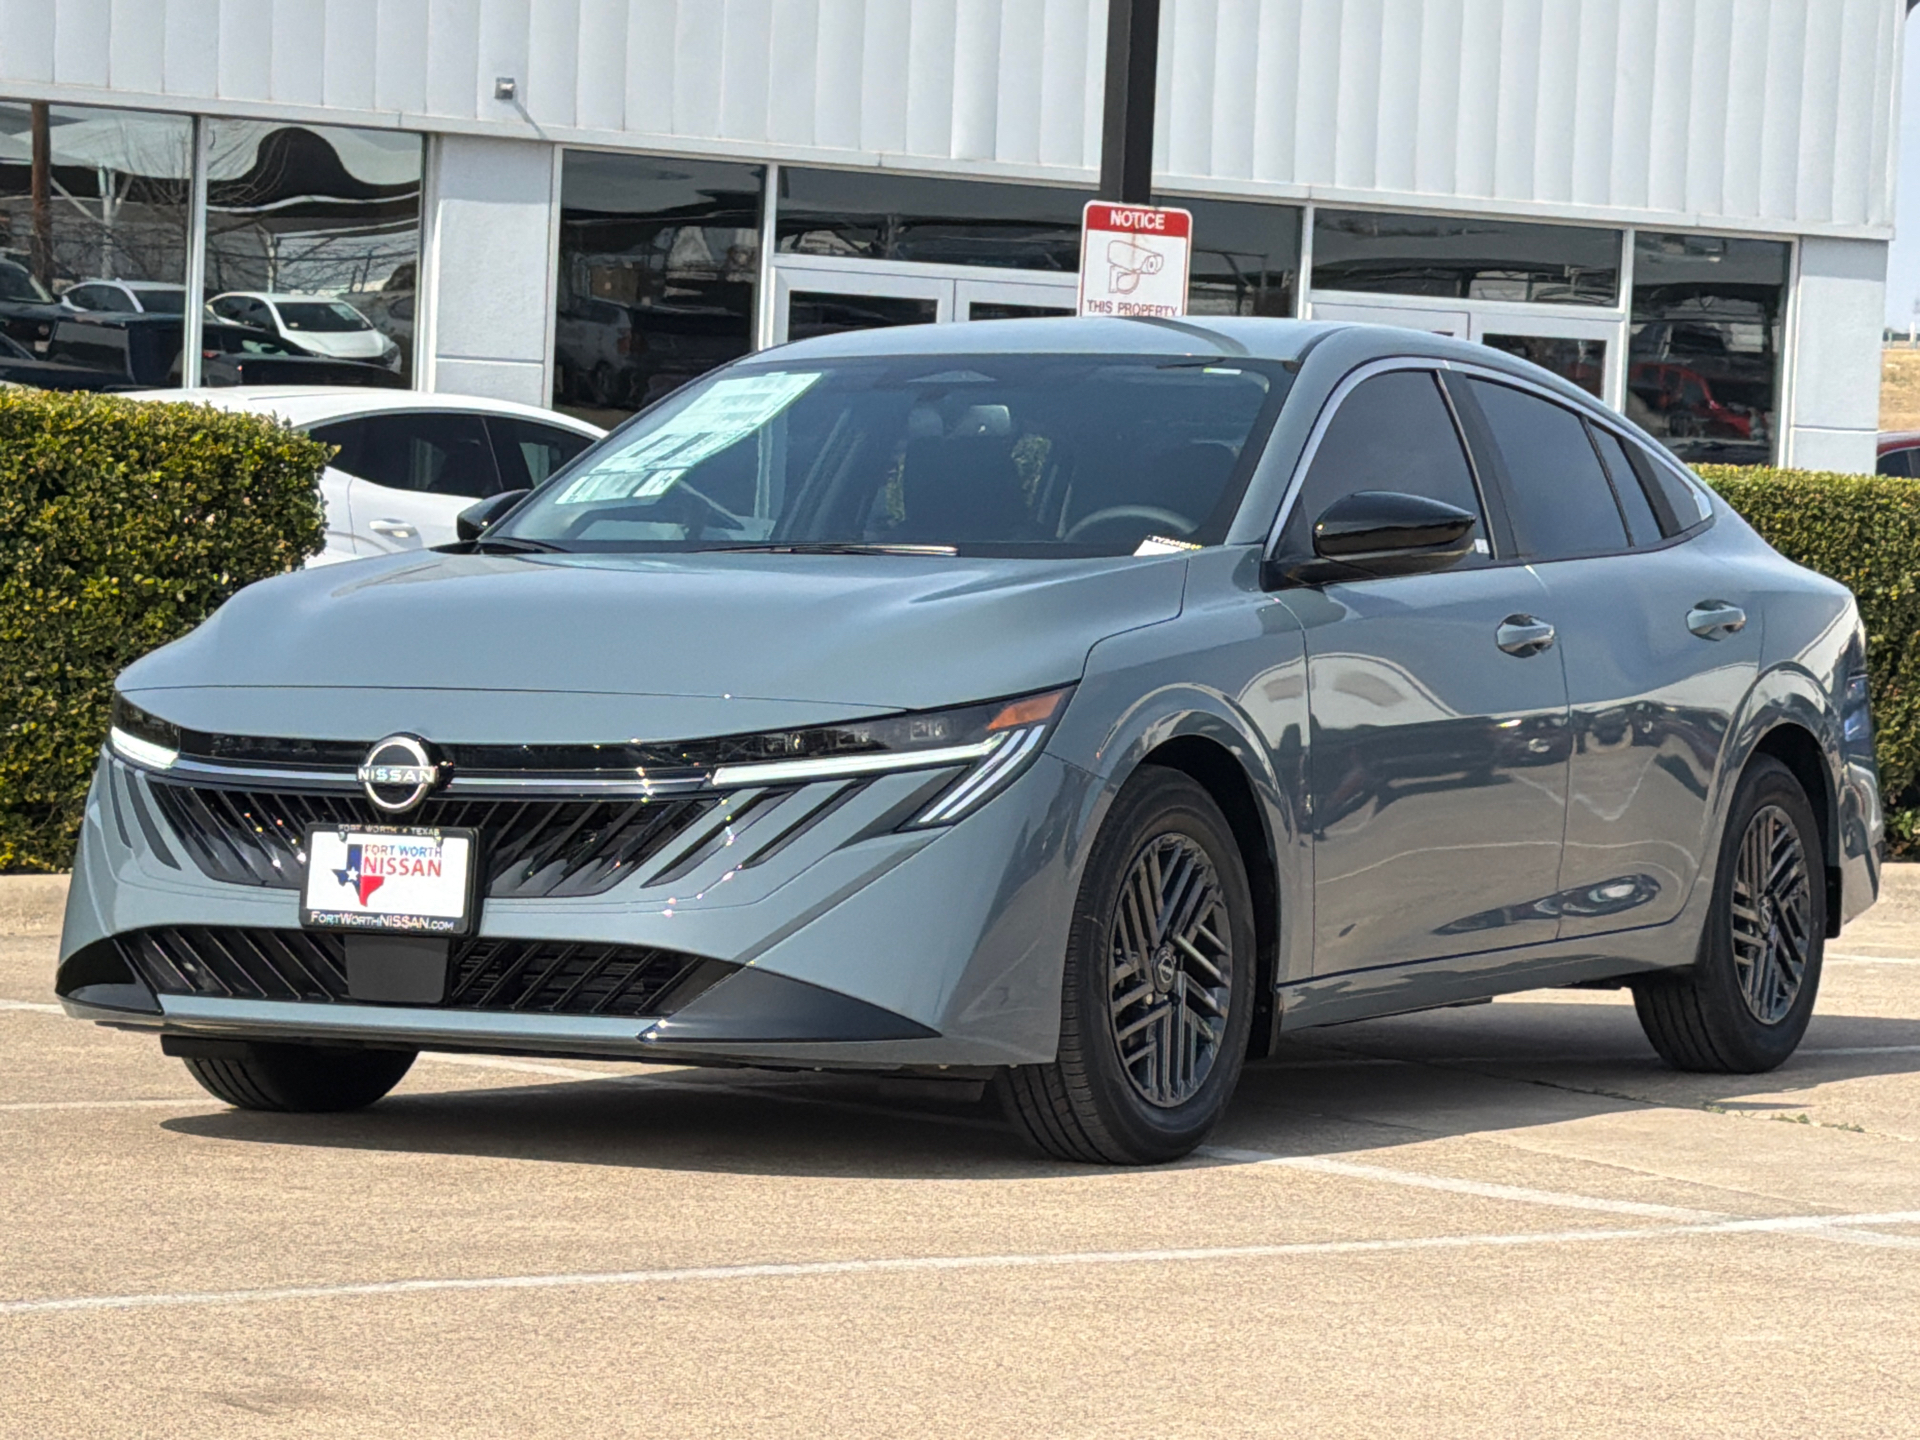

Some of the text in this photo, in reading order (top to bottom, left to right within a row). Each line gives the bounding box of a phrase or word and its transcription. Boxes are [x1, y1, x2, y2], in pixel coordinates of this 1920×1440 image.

[1110, 209, 1166, 230] NOTICE
[1087, 299, 1178, 317] THIS PROPERTY
[358, 768, 434, 783] NISSAN
[338, 824, 441, 836] FORT WORTH TEXAS
[365, 844, 442, 858] FORT WORTH
[363, 856, 442, 878] NISSAN
